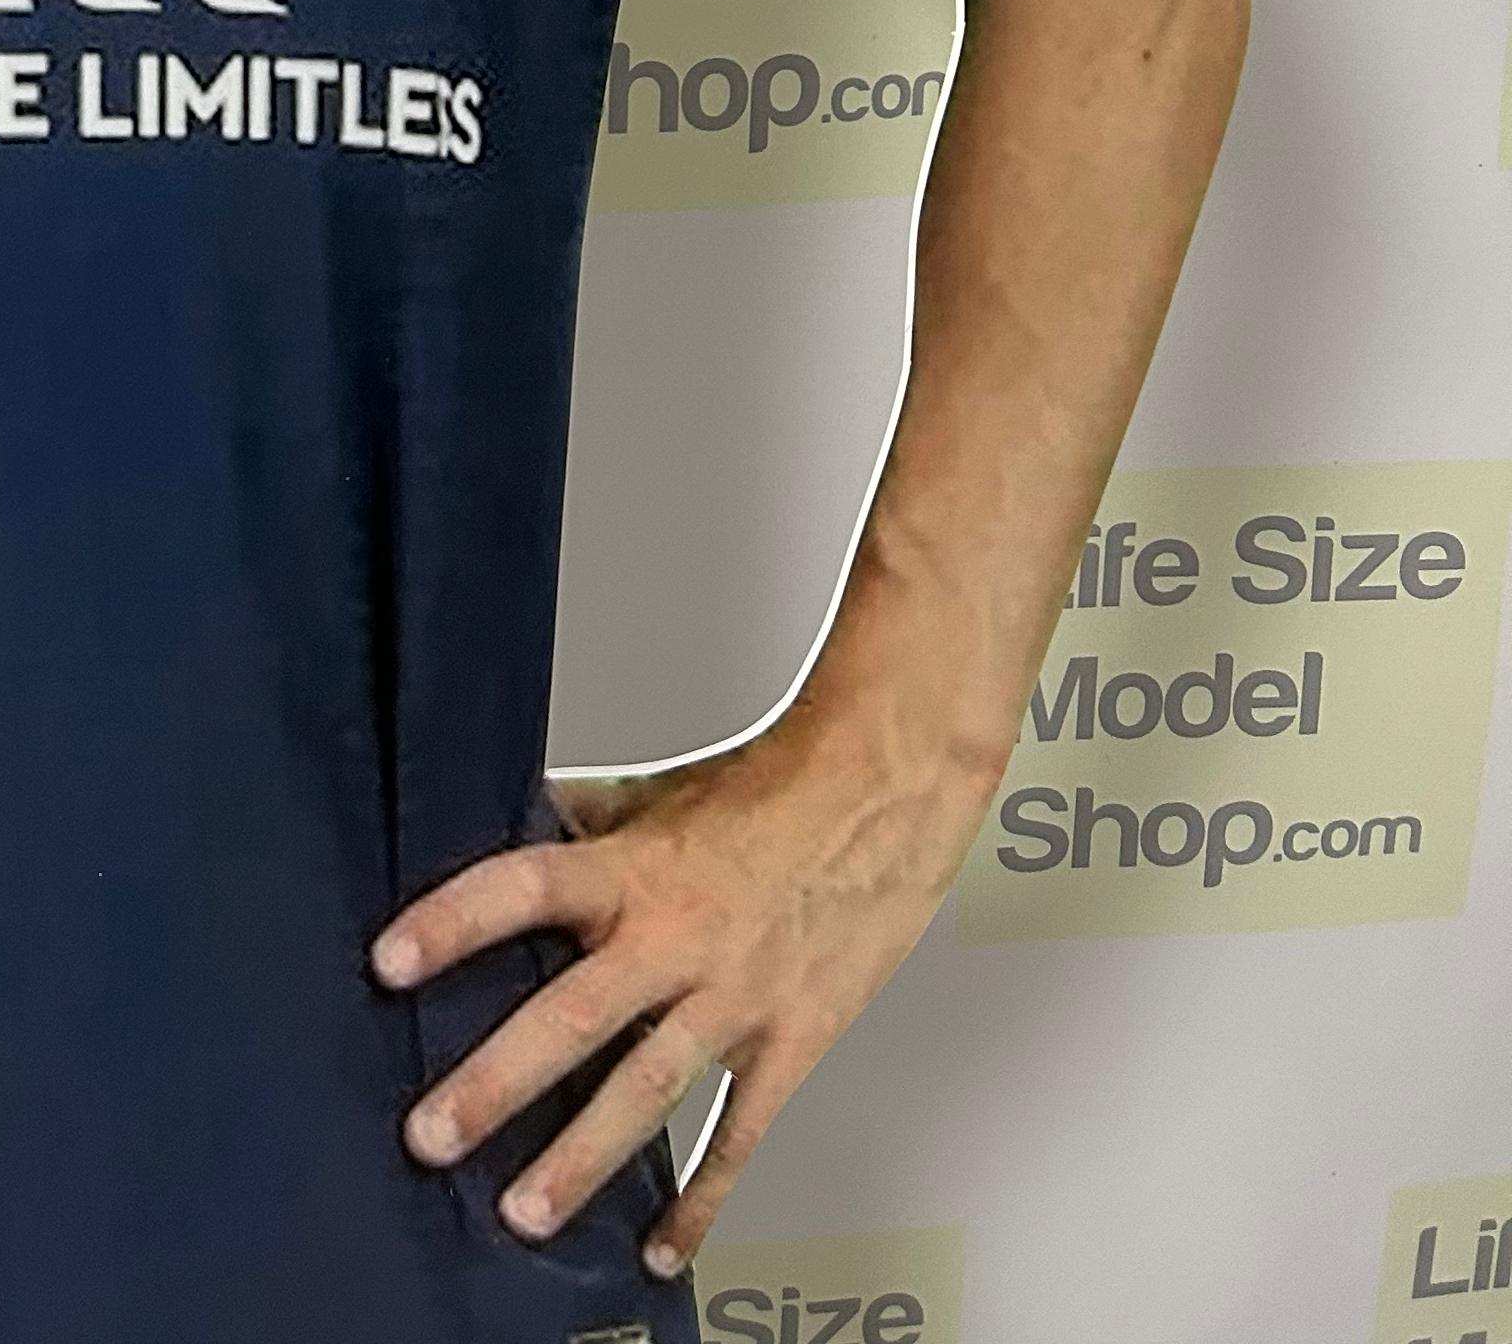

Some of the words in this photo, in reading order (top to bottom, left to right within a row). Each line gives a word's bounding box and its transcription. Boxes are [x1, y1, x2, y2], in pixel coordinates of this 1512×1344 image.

[1063, 521, 1200, 610] ife
[1231, 515, 1466, 604] Size
[996, 787, 1423, 888] Shop.com
[702, 1286, 925, 1344] Size
